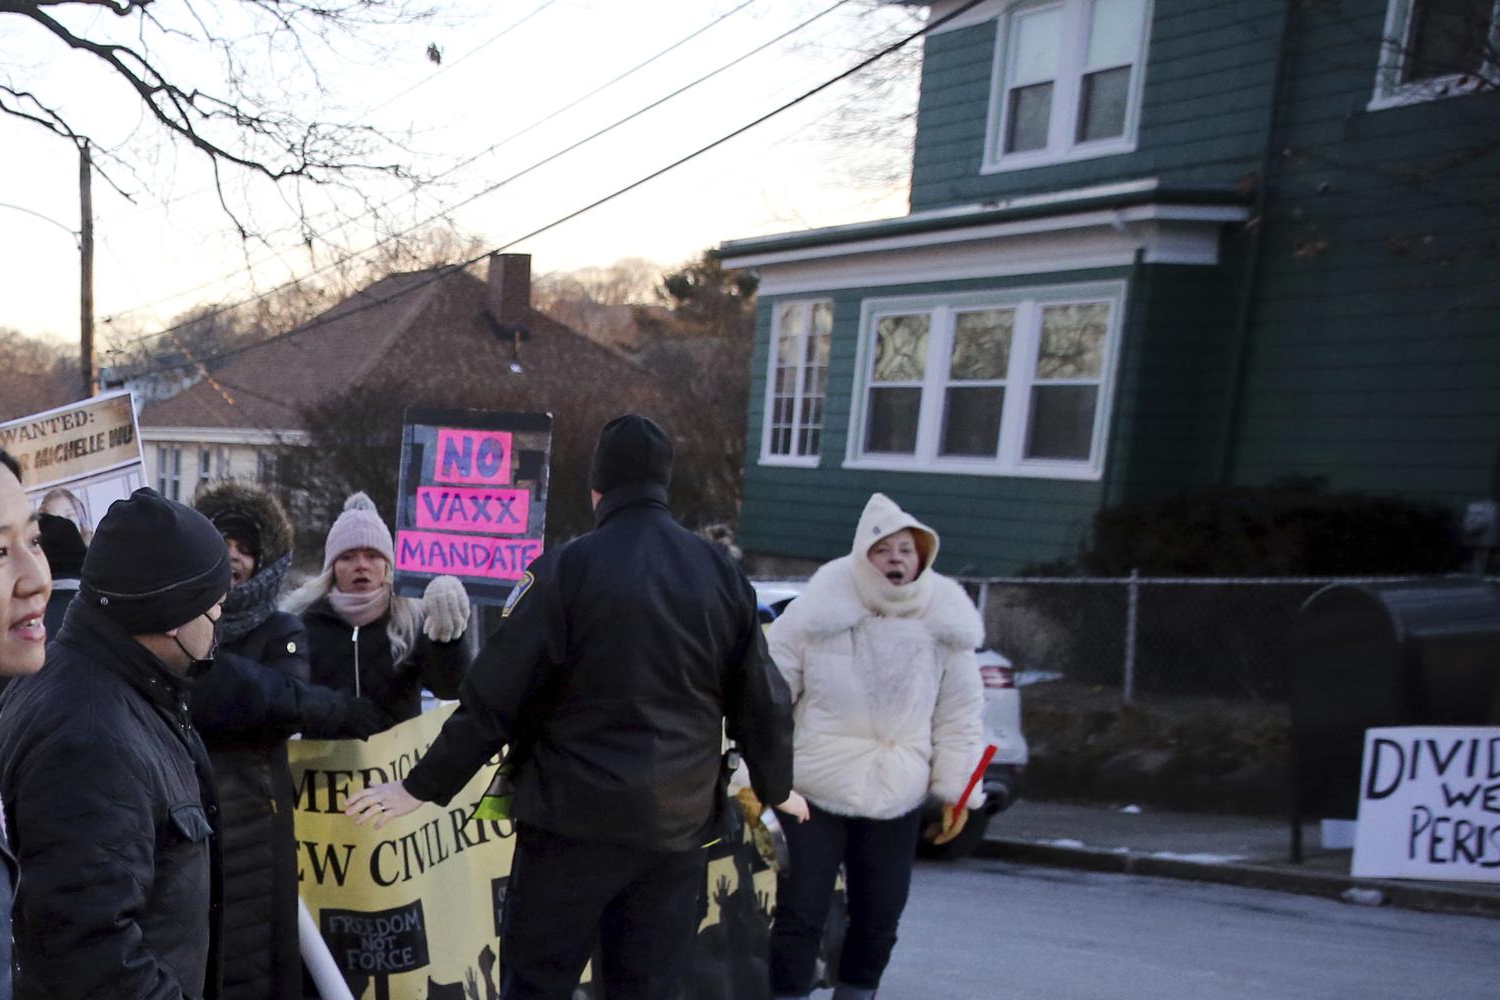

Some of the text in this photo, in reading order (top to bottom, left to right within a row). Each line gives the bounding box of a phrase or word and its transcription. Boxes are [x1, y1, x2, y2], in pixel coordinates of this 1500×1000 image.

[34, 431, 105, 468] MICHELLE
[109, 424, 133, 448] WU
[441, 436, 504, 478] NO
[422, 491, 520, 524] VAXX
[401, 538, 537, 572] MANDATE
[1441, 783, 1500, 815] WE
[369, 819, 449, 887] CIVIL
[329, 907, 421, 936] FREEDOM
[348, 947, 416, 971] FORCE
[361, 935, 396, 951] NOT
